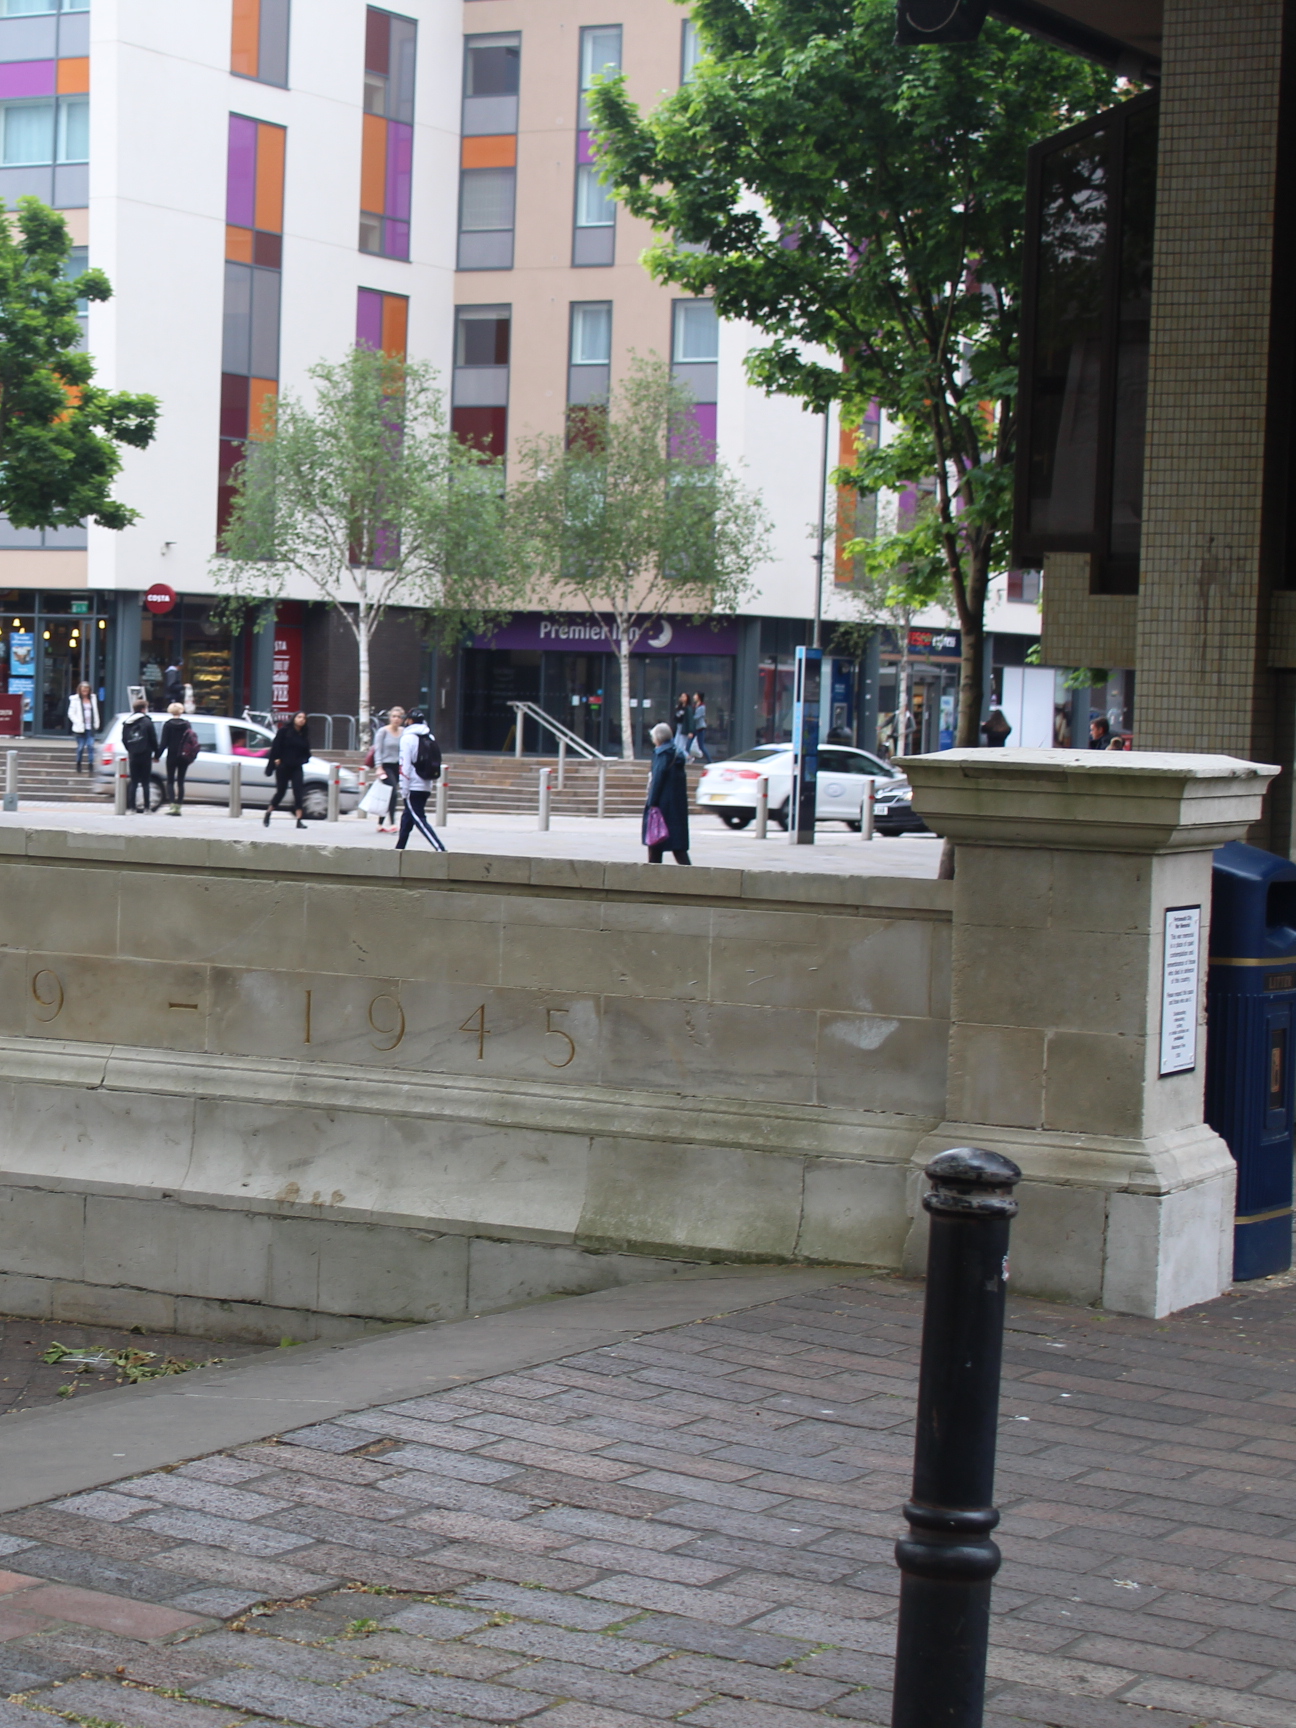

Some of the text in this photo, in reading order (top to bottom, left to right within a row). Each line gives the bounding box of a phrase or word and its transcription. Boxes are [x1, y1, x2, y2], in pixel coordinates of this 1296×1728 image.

[147, 594, 170, 603] COSTA
[539, 621, 610, 640] Premier
[274, 640, 287, 652] STA
[304, 989, 576, 1069] 1945
